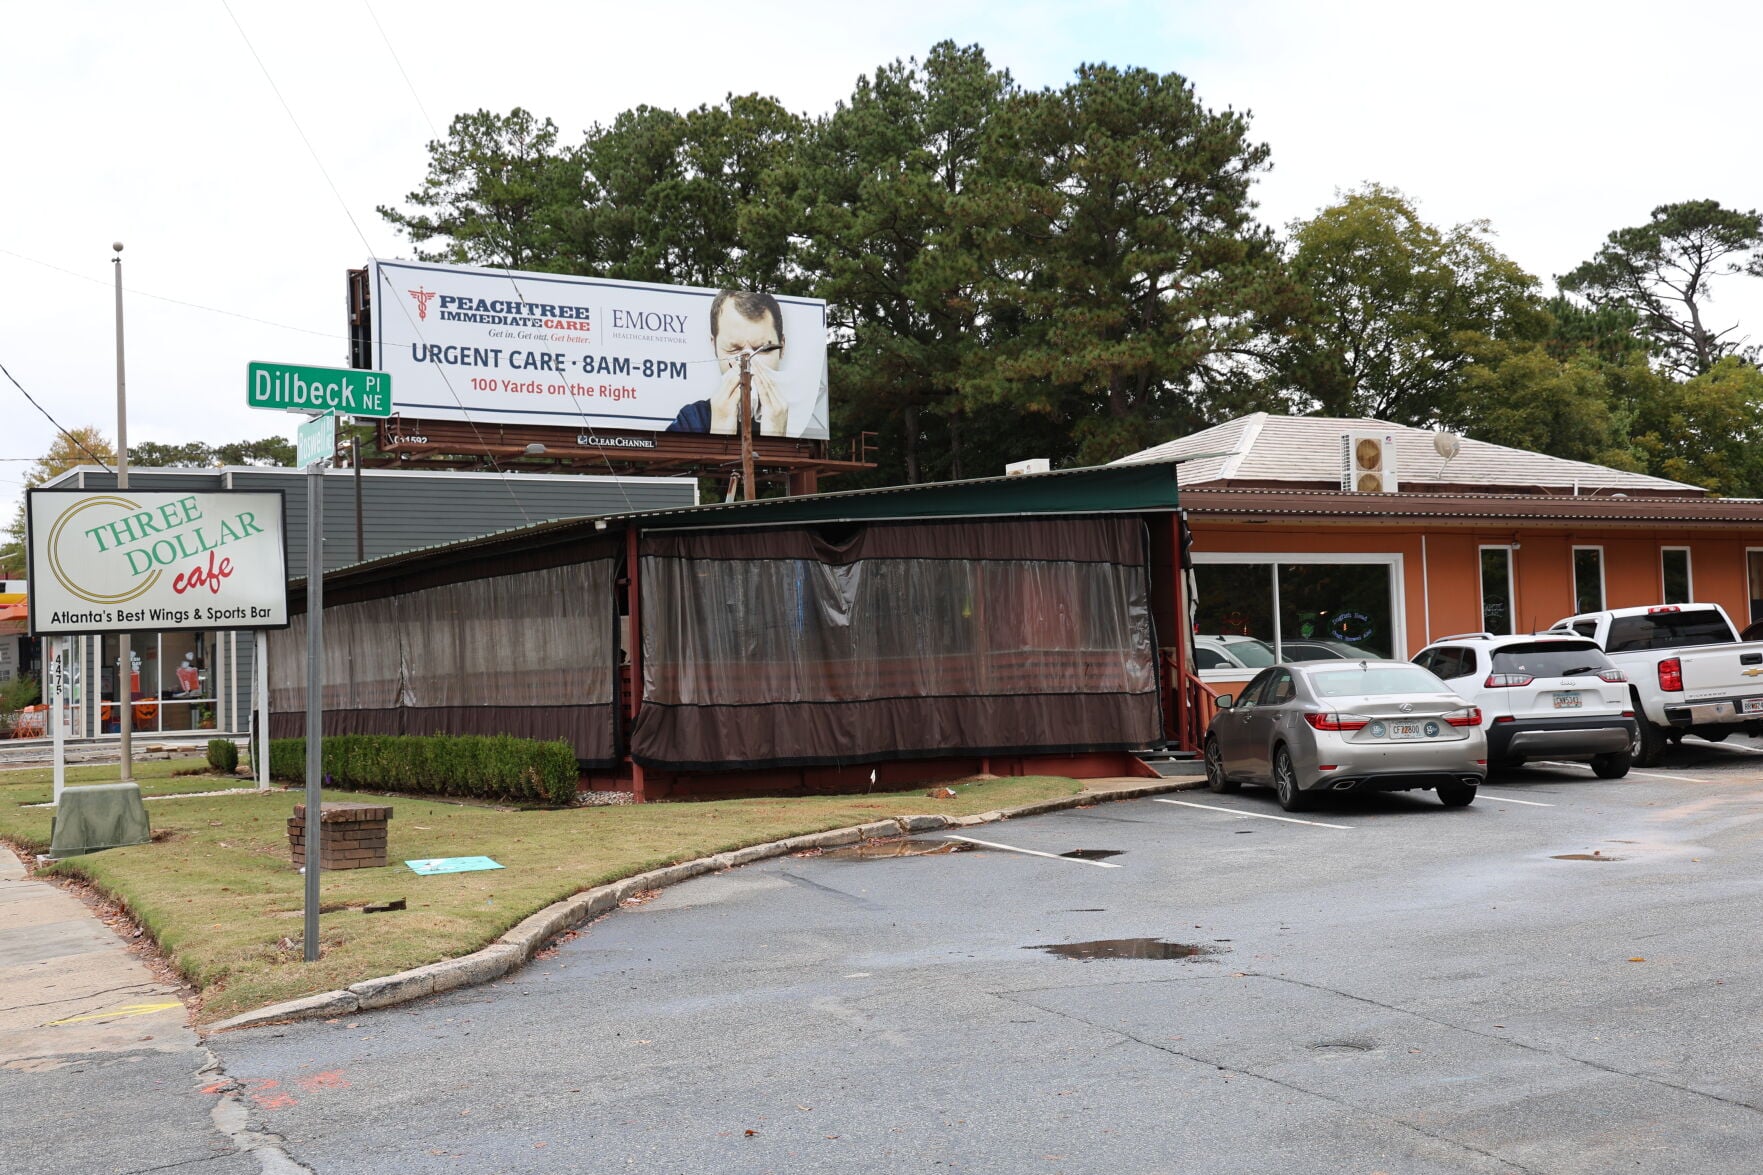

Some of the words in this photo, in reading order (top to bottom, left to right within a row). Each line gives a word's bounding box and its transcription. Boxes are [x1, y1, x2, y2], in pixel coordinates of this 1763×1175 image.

[439, 294, 590, 321] PEACHTREE
[612, 309, 688, 334] EMORY
[488, 329, 503, 340] Get
[517, 331, 533, 342] Get
[550, 333, 565, 344] Get
[566, 334, 591, 345] better.
[612, 331, 654, 342] HEALTHCARE
[655, 335, 687, 345] NETWORK
[412, 343, 502, 368] URGENT
[509, 350, 566, 372] CARE
[582, 354, 688, 380] 8AM-8PM
[255, 369, 356, 408] Dilbeck
[470, 377, 498, 392] 100
[501, 380, 543, 394] Yards
[547, 384, 566, 395] on
[571, 384, 594, 397] the
[599, 384, 637, 401] Right
[363, 394, 383, 411] NE
[85, 495, 203, 553] THREE
[122, 511, 264, 577] DOLLAR
[172, 549, 234, 594] cafe
[50, 609, 113, 625] Atlanta's
[116, 609, 145, 622] Best
[149, 608, 190, 624] Wings
[193, 608, 203, 620] &
[207, 606, 247, 622] Sports
[250, 606, 272, 619] Bar
